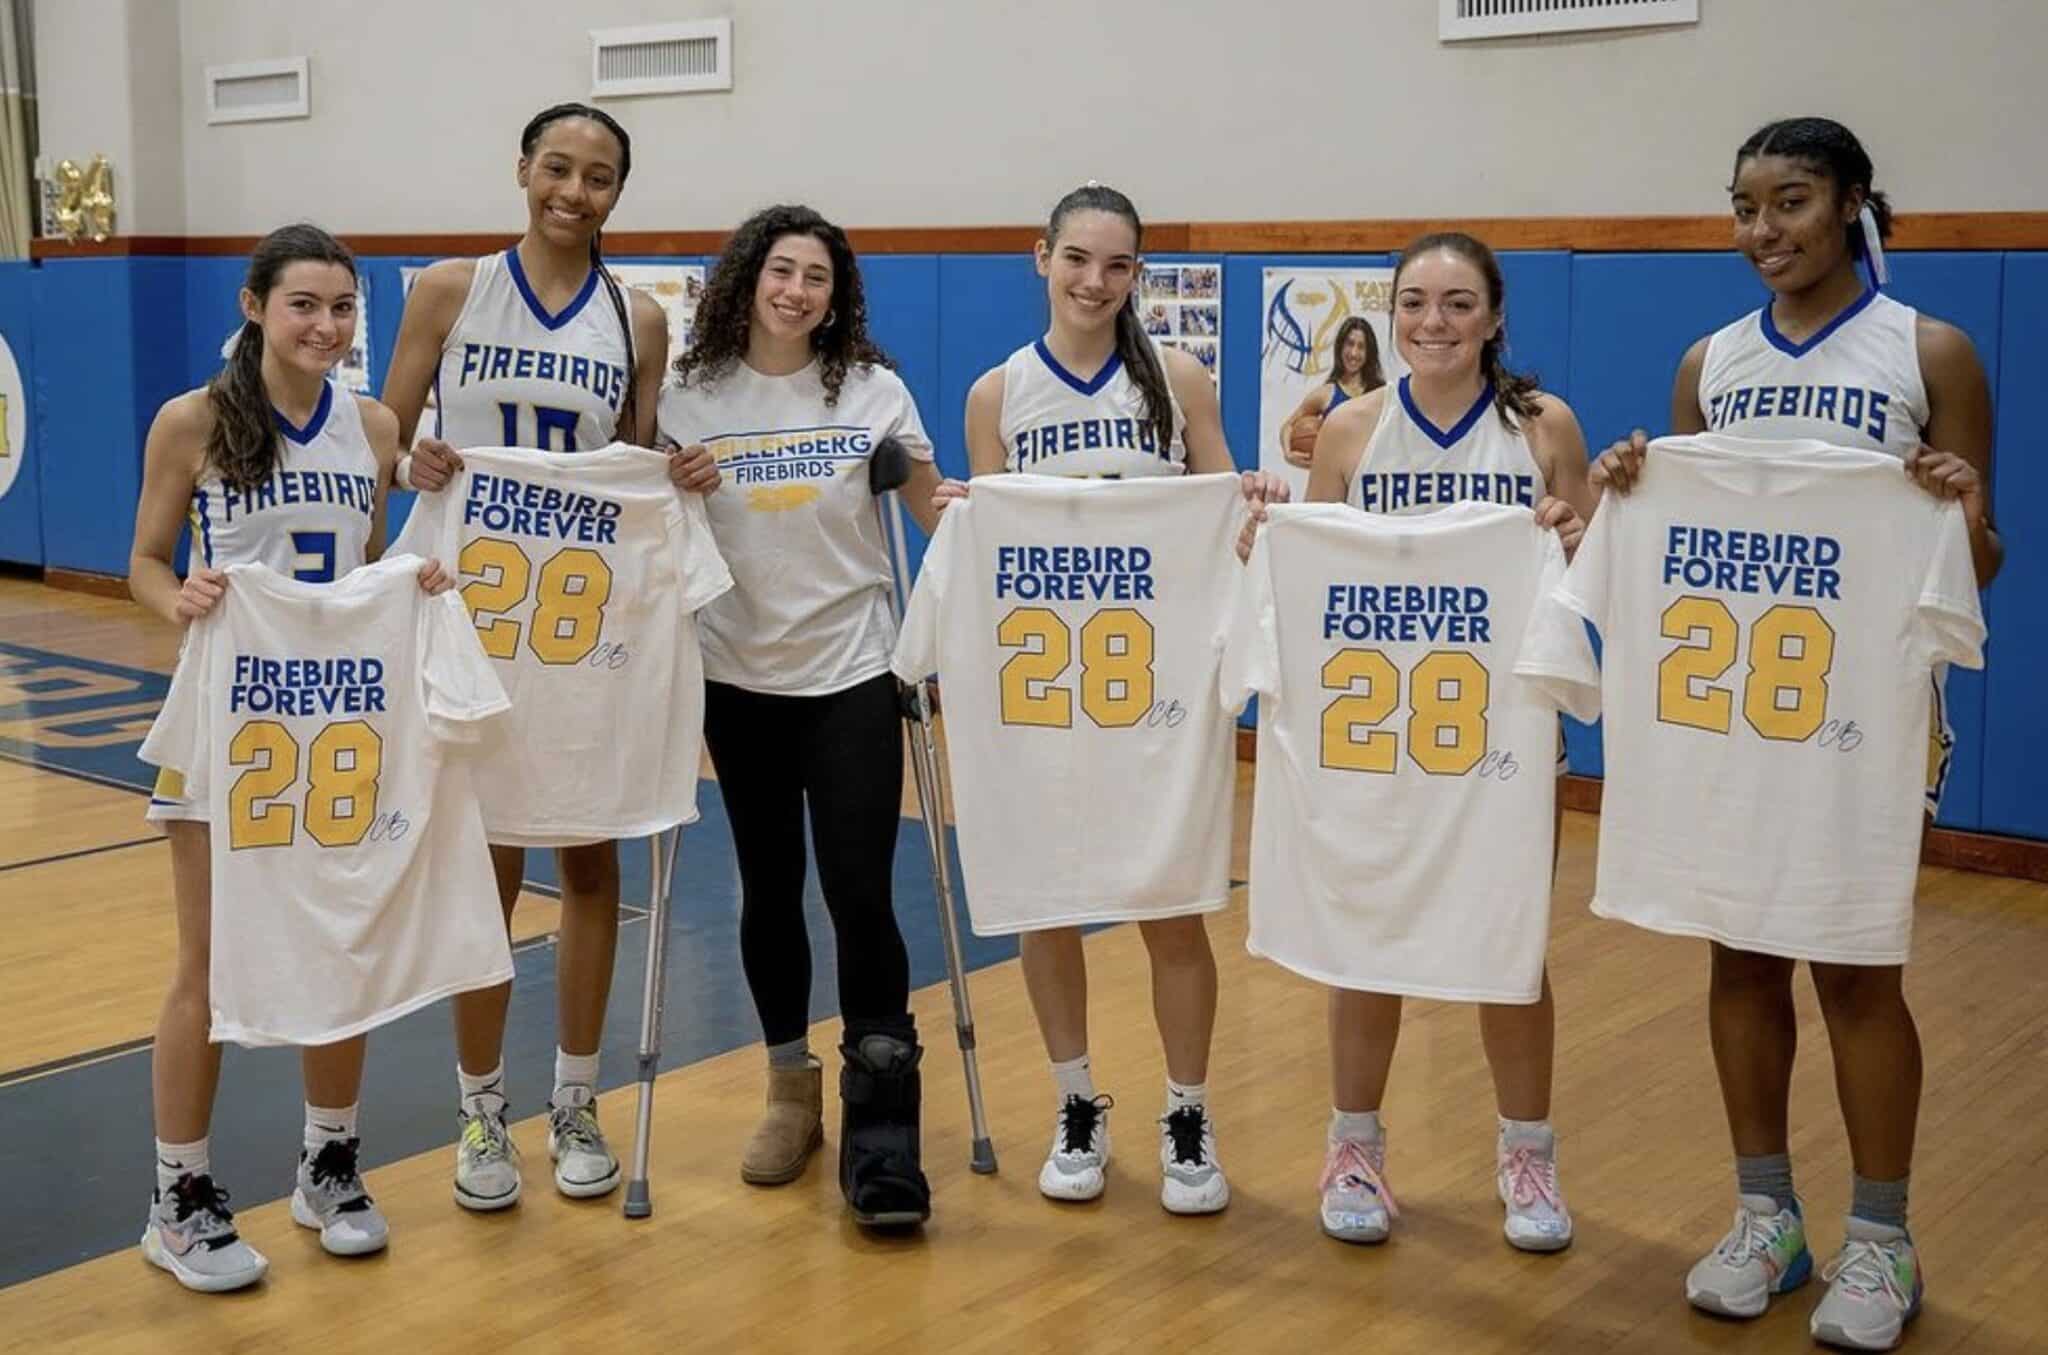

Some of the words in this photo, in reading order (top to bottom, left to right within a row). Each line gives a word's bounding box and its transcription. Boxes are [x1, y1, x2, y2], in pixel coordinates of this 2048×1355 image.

[459, 343, 625, 412] FIREBIRDS
[1710, 386, 1890, 444] FIREBIRDS
[736, 461, 835, 484] FIREBIRDS
[470, 472, 622, 519] FIREBIRD
[464, 499, 617, 544] FOREVER
[998, 546, 1153, 574] FIREBIRD
[1668, 525, 1841, 567] FIREBIRD
[996, 573, 1155, 600] FOREVER
[1328, 584, 1489, 614] FIREBIRD
[1664, 556, 1841, 600] FOREVER
[458, 536, 613, 665] 28
[1323, 613, 1491, 643] FOREVER
[235, 655, 384, 688] FIREBIRD
[996, 606, 1154, 729] 28
[1656, 594, 1836, 743] 28
[230, 684, 387, 716] FOREVER
[1320, 647, 1490, 776] 28
[228, 719, 384, 851] 28
